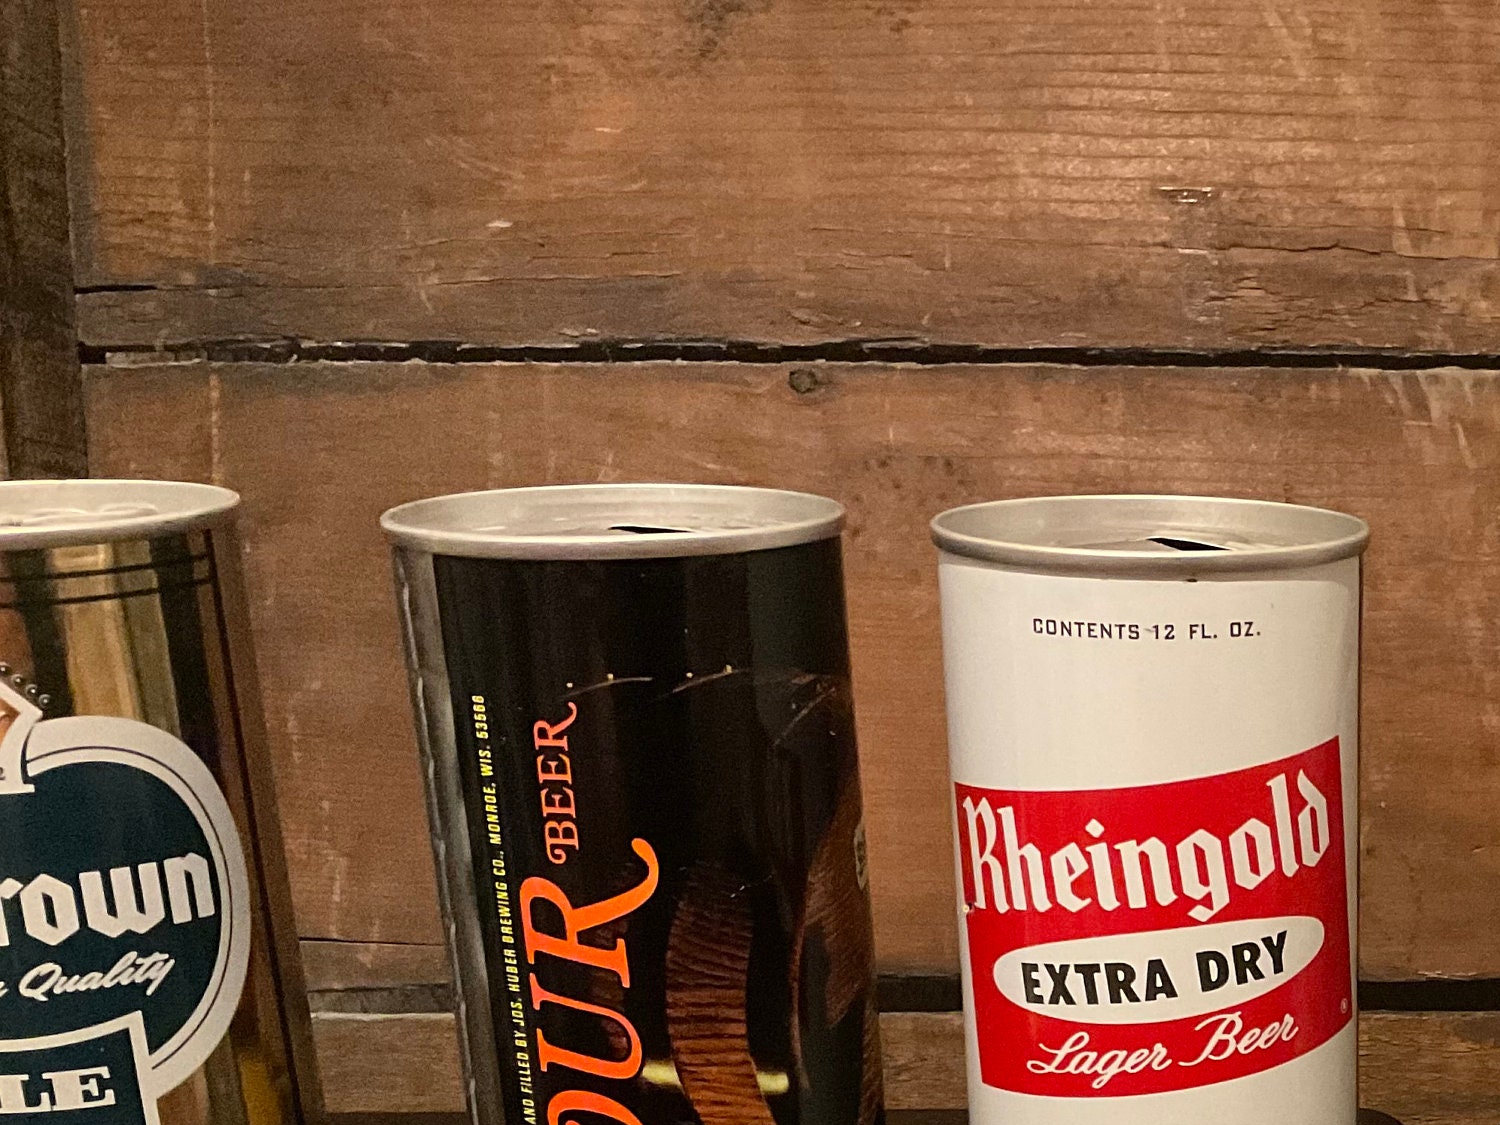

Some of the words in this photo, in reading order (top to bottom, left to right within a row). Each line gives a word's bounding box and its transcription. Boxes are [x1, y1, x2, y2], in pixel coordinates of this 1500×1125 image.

[1032, 618, 1141, 641] CONTENTS
[1152, 623, 1176, 641] 12
[1189, 624, 1218, 641] FL.
[1229, 620, 1262, 638] OZ.
[479, 745, 493, 777] WIS.
[533, 701, 578, 865] BEER
[962, 769, 1330, 922] Rheingold
[495, 881, 516, 944] BREWING
[18, 951, 176, 1002] Quality
[503, 948, 520, 992] HUBER
[1021, 958, 1180, 1007] EXTRA
[1195, 929, 1288, 993] DRY
[514, 1030, 529, 1049] BY
[1026, 1031, 1172, 1090] Lager
[1178, 1011, 1299, 1067] Beer
[516, 1052, 533, 1094] FILLED
[522, 1098, 537, 1125] AND
